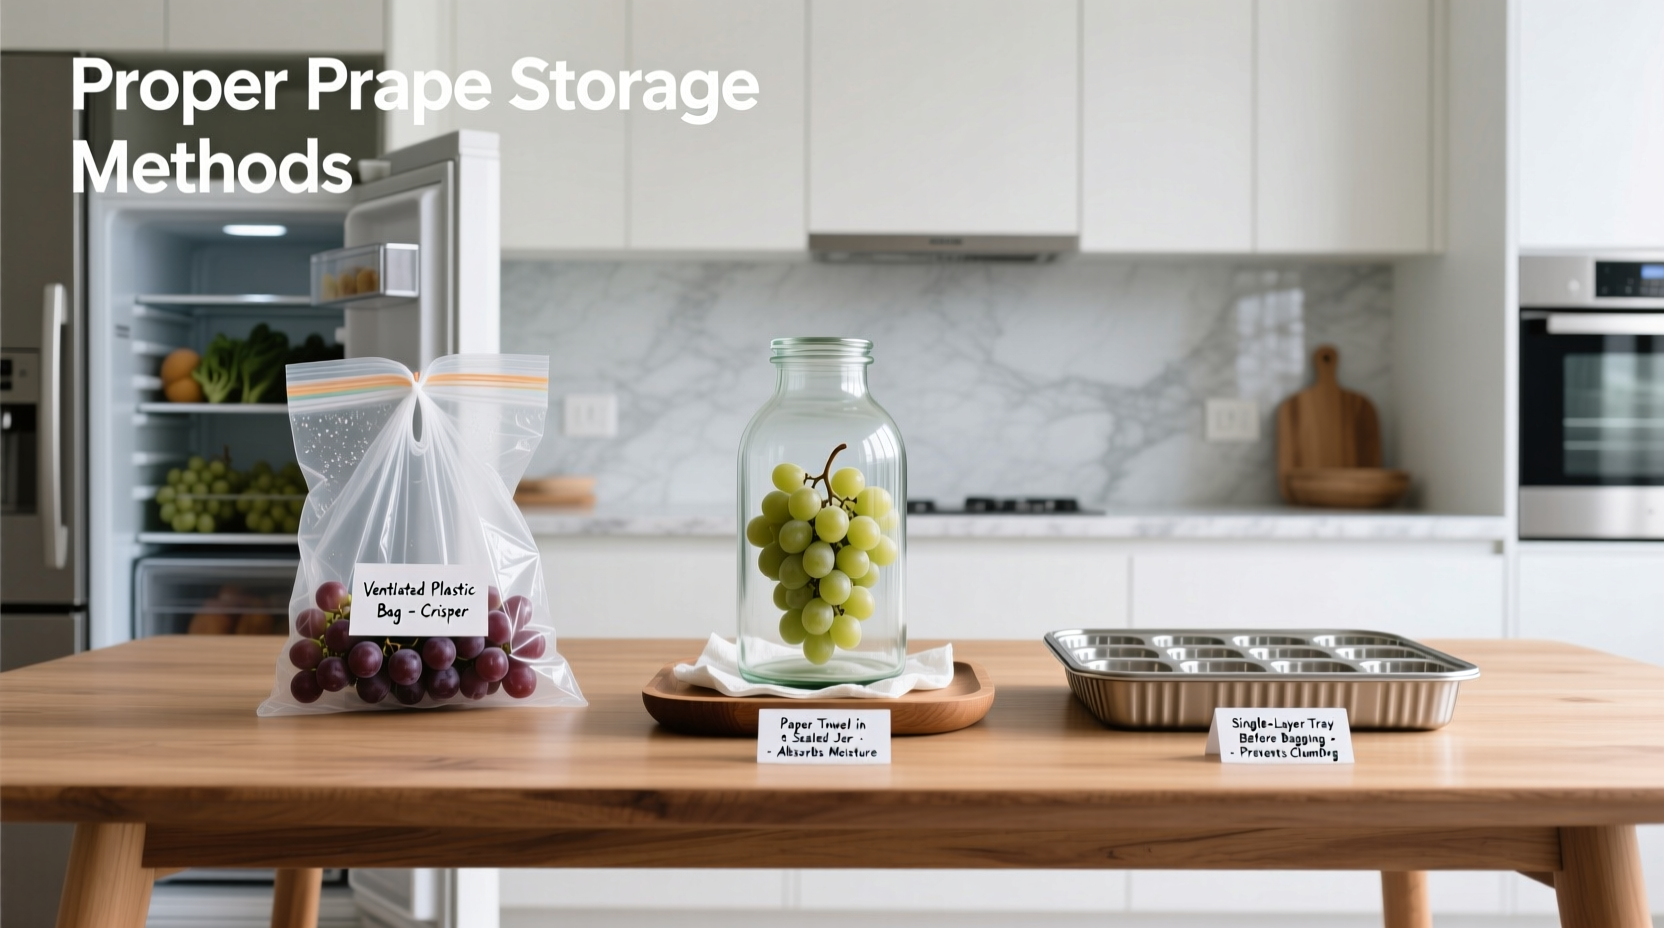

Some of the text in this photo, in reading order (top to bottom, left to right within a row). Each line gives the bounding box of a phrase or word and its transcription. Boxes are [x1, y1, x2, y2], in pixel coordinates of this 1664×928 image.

[431, 580, 476, 597] Plastic
[377, 602, 402, 625] Bag
[420, 602, 469, 625] Crisper
[780, 716, 813, 735] Paper
[856, 717, 866, 730] in
[1231, 716, 1334, 732] Single-Layer Tray
